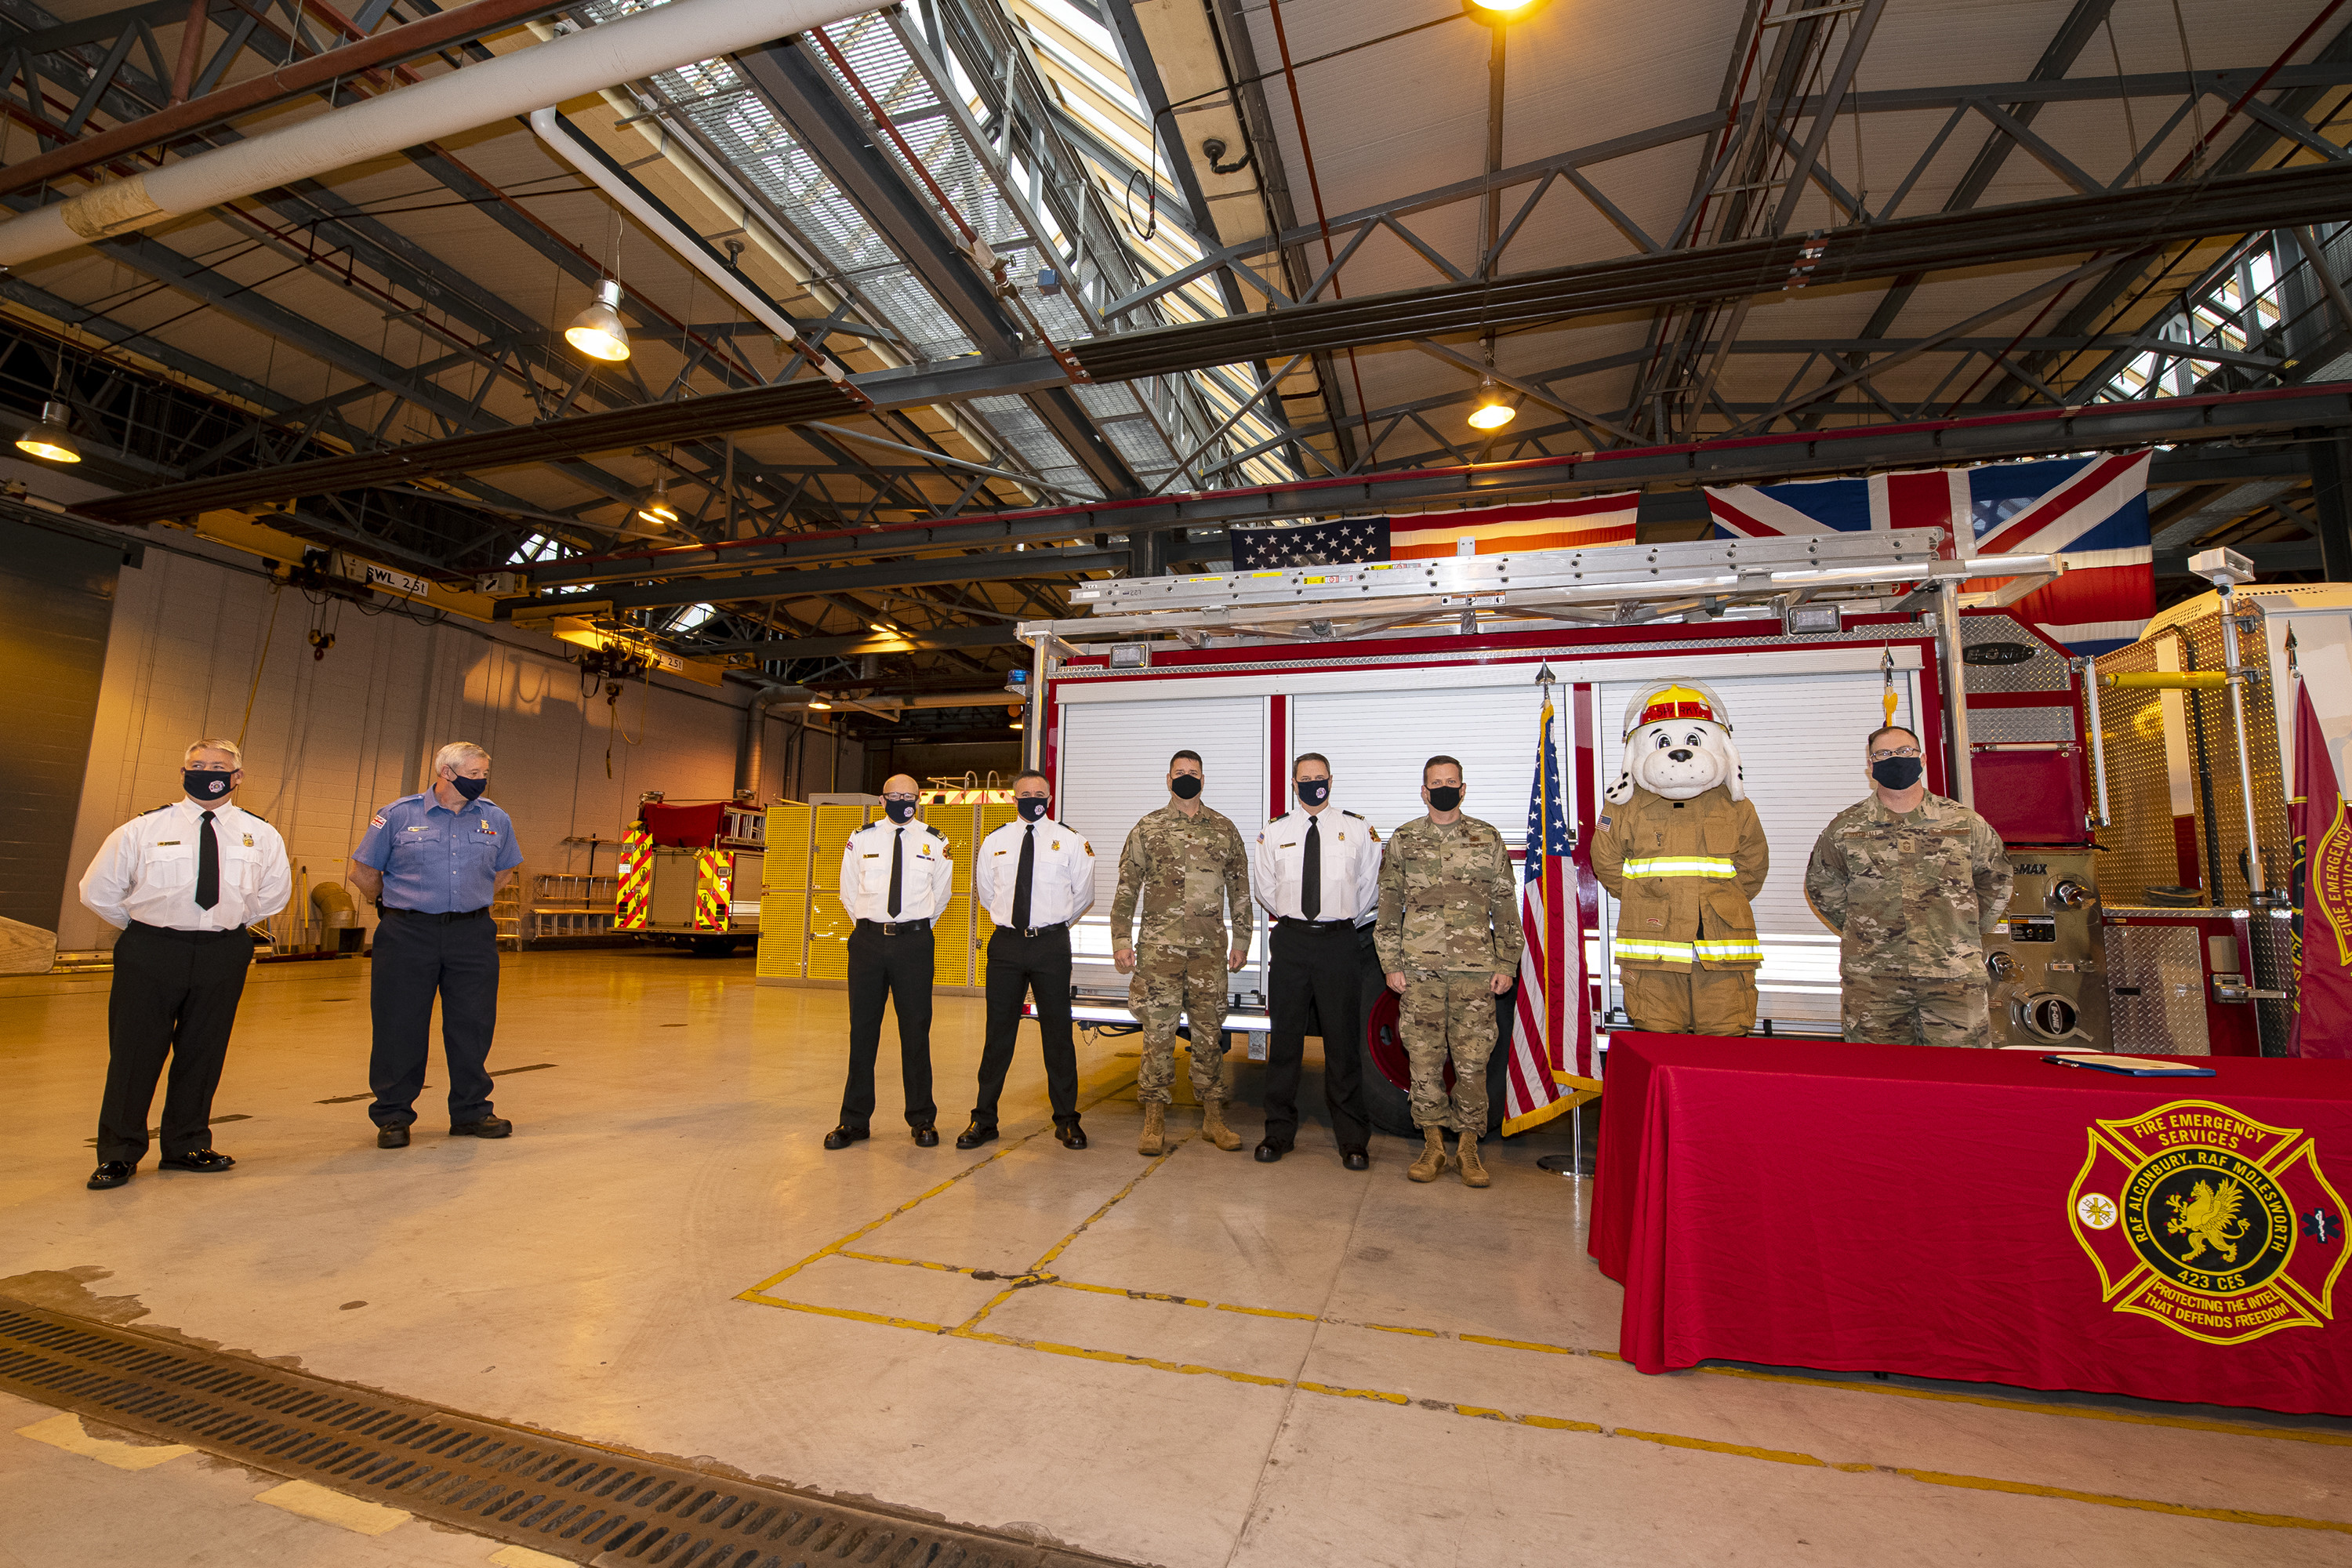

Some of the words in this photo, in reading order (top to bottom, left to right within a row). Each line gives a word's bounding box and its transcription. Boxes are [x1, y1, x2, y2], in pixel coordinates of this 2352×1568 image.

[368, 567, 395, 585] SWL
[2326, 823, 2352, 902] EMERGENCY
[719, 877, 728, 891] 5
[2332, 906, 2352, 935] FIRE
[2050, 1005, 2060, 1029] E-ONE
[2132, 1117, 2167, 1138] FIRE
[2169, 1114, 2267, 1143] EMERGENCY
[2158, 1129, 2240, 1149] SERVICES
[2198, 1152, 2229, 1167] RAF
[2129, 1152, 2193, 1211] ALCONBURY,
[2232, 1162, 2288, 1253] MOLESWORTH
[2129, 1217, 2149, 1243] RAF
[2177, 1270, 2209, 1289] 423
[2217, 1274, 2246, 1290] CES
[2144, 1292, 2174, 1316] THAT
[2175, 1307, 2233, 1328] DEFENDS
[2234, 1302, 2290, 1327] FREEDOM
[2152, 1281, 2223, 1313] PROTECTING
[2224, 1298, 2247, 1312] THE
[2246, 1290, 2280, 1309] INTEL
